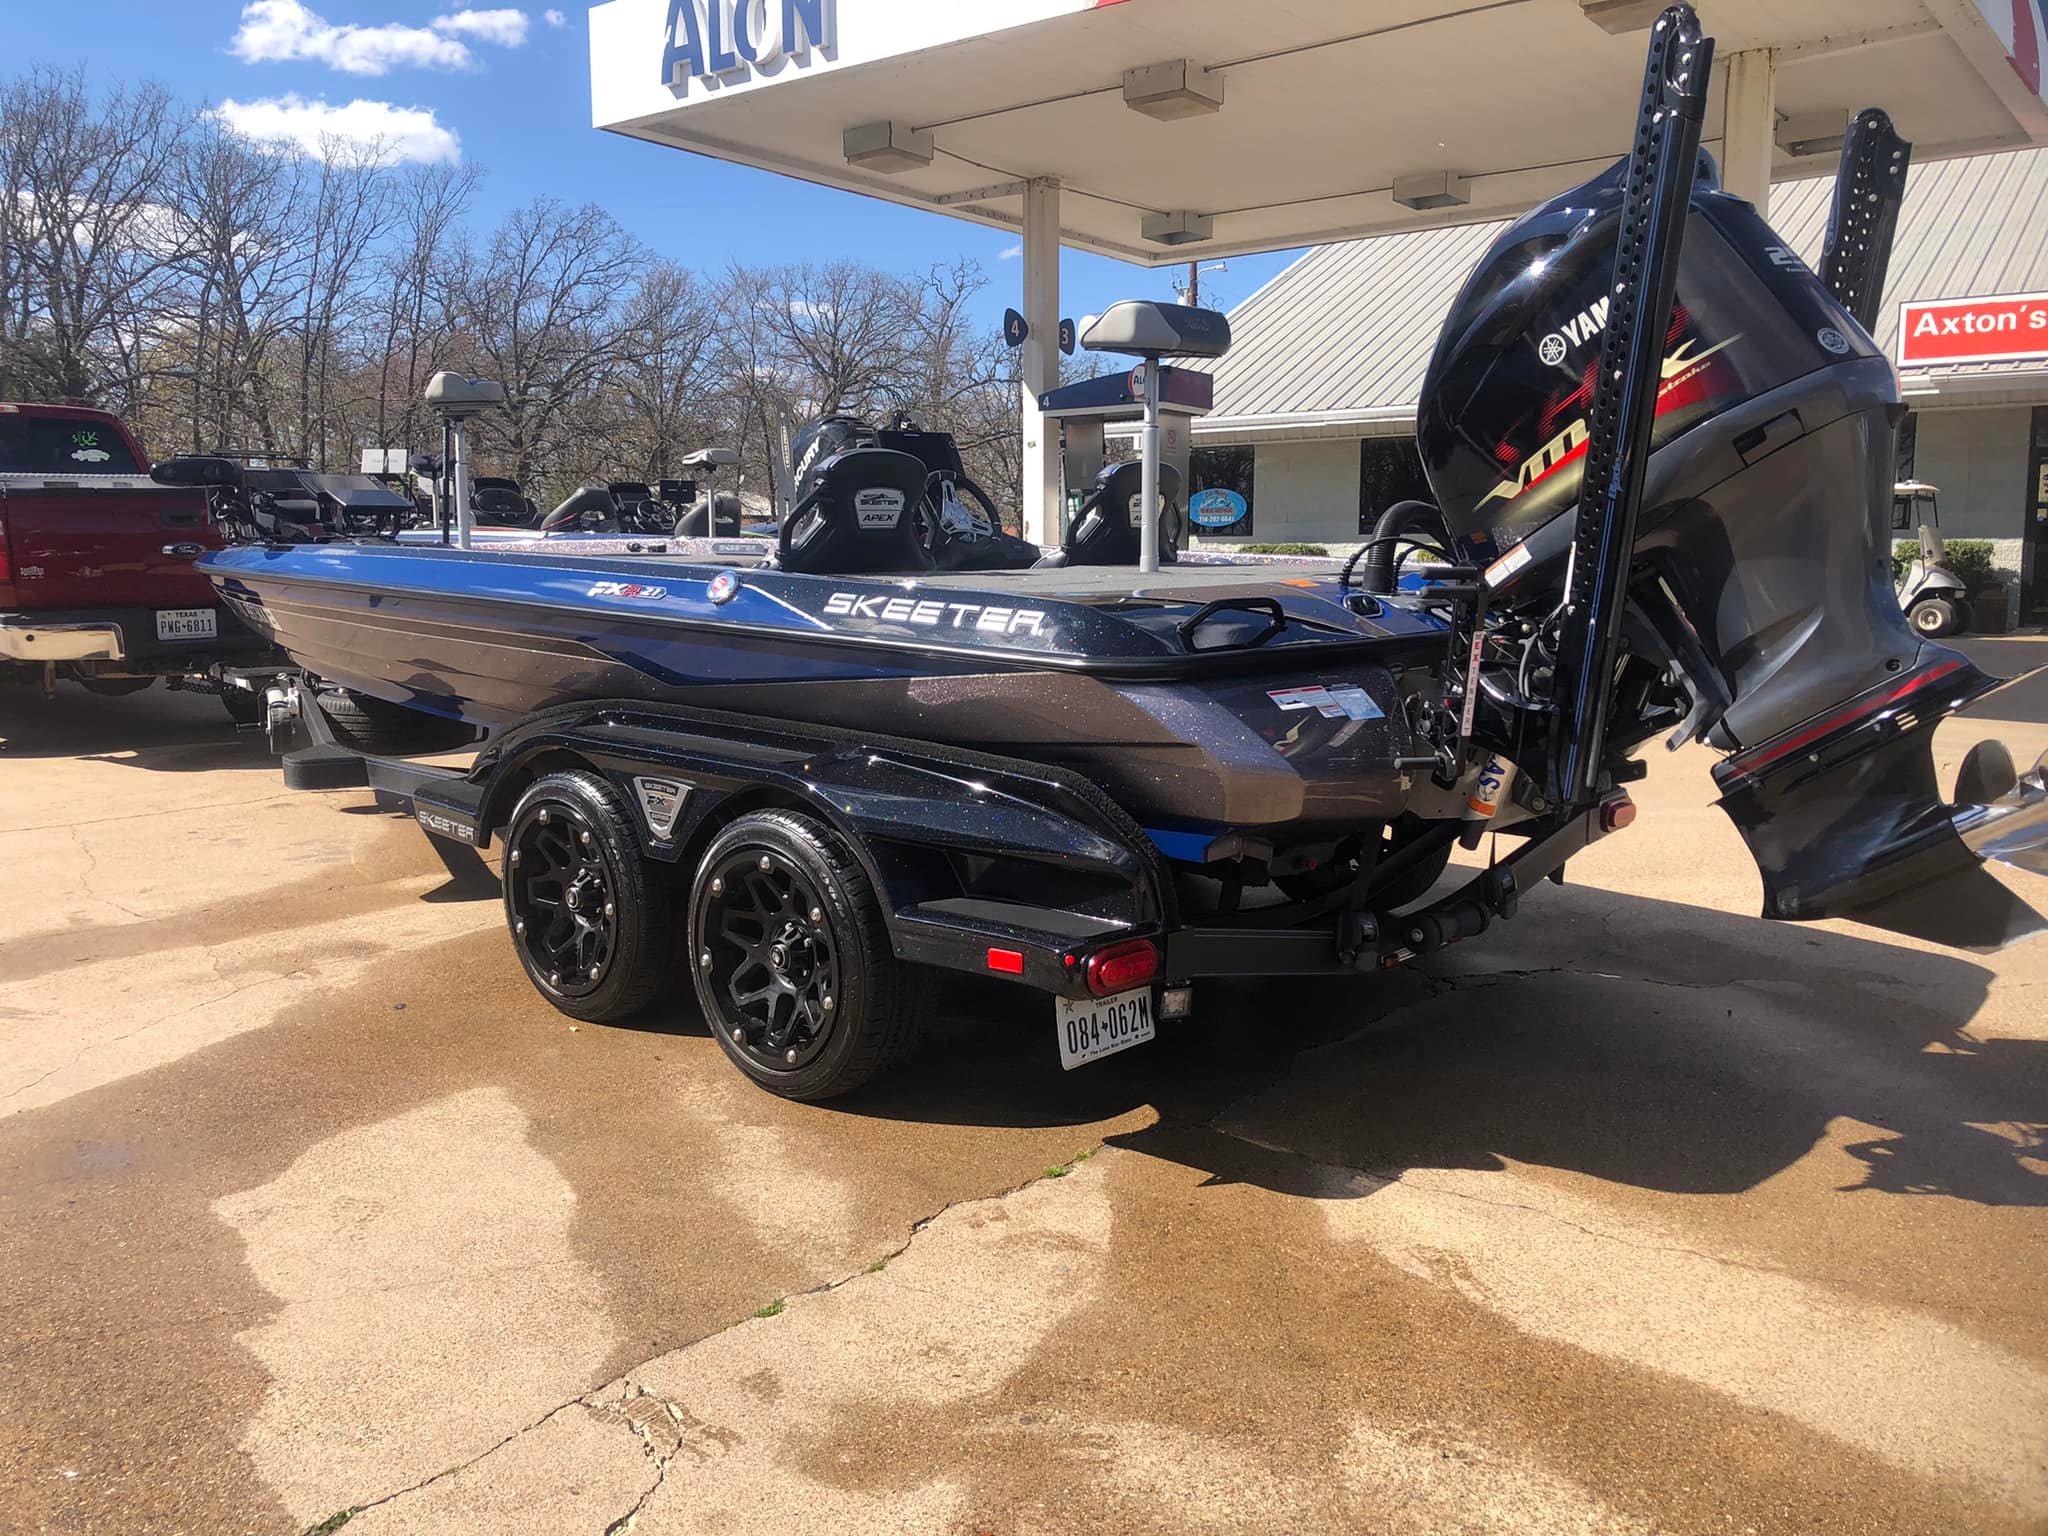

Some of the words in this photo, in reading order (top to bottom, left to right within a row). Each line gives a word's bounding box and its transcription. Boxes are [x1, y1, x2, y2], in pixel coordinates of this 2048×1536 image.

[1011, 319, 1020, 337] 4
[1912, 304, 2047, 337] Axton's
[1061, 327, 1069, 345] 3
[1042, 396, 1050, 408] 4
[863, 514, 895, 522] APEX
[823, 592, 1046, 636] SKEETER
[419, 810, 475, 841] SKEETER
